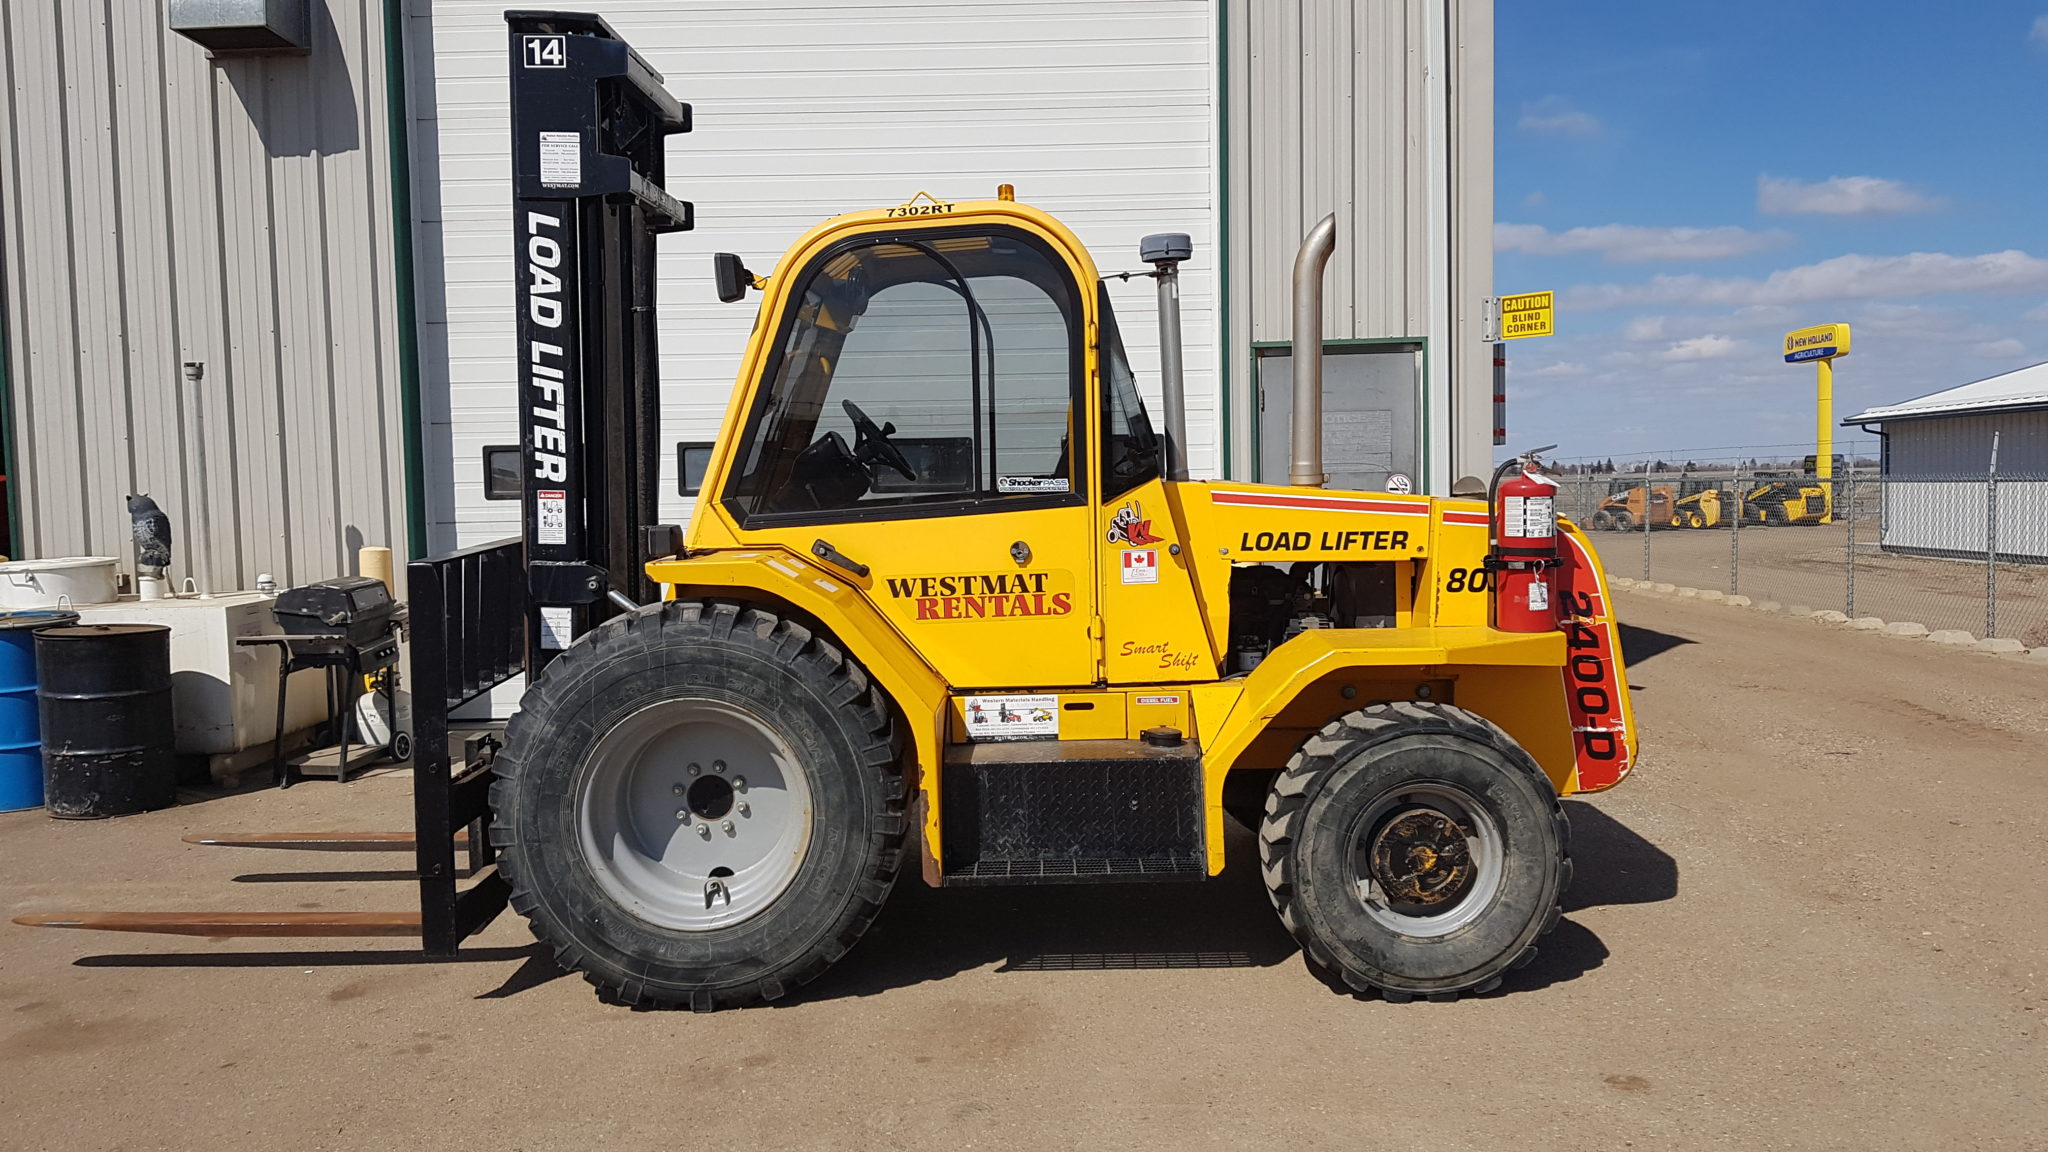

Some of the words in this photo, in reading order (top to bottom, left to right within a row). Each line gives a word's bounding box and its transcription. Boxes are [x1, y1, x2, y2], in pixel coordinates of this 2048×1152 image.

[528, 39, 562, 65] 14
[886, 203, 955, 218] 7302RT
[528, 211, 562, 329] LOAD
[1504, 295, 1549, 311] CAUTION
[1507, 321, 1546, 333] CORNER
[1512, 312, 1541, 323] BLIND
[1795, 337, 1808, 347] NEW
[1808, 332, 1833, 345] HOLLAND
[1794, 348, 1824, 360] AGRICULTURE
[531, 340, 567, 483] LIFTER
[1240, 532, 1311, 551] LOAD
[1320, 530, 1409, 550] LIFTER
[886, 573, 1049, 598] WESTMAT
[1446, 567, 1491, 593] 80
[915, 592, 1072, 621] RENTALS
[1120, 641, 1169, 656] Smart
[1159, 651, 1199, 671] Shift
[1558, 589, 1617, 760] 2400-D
